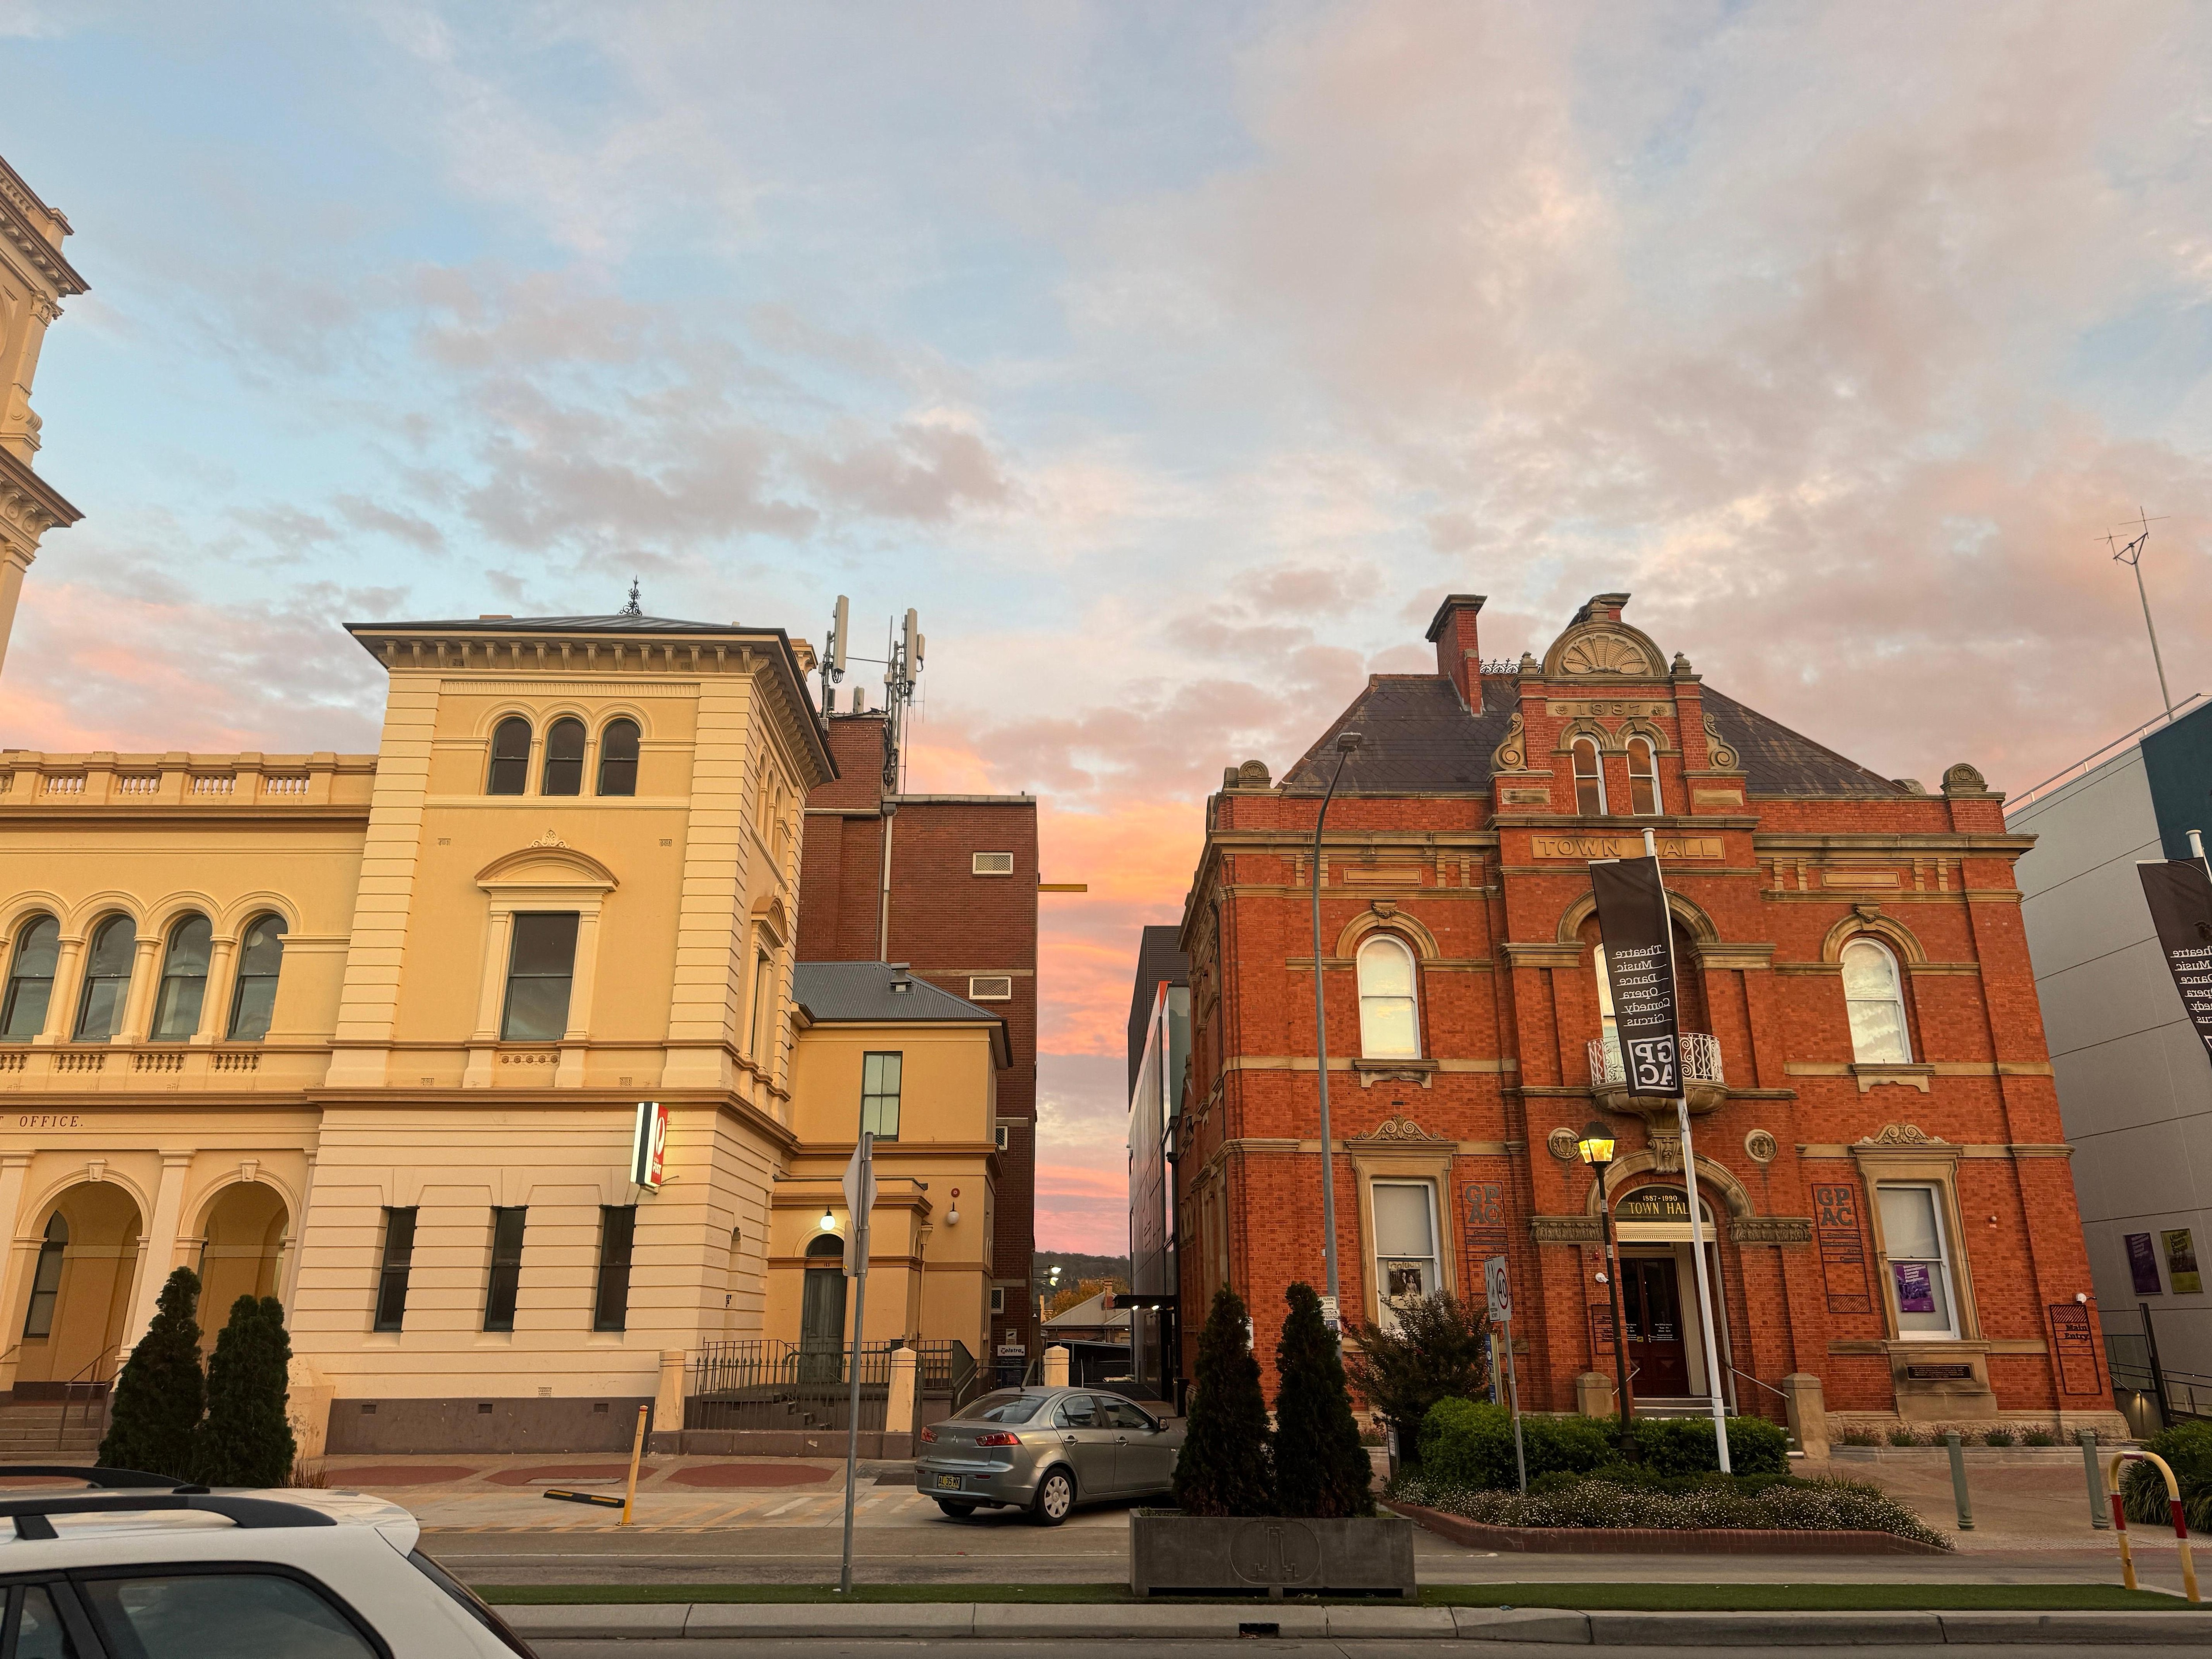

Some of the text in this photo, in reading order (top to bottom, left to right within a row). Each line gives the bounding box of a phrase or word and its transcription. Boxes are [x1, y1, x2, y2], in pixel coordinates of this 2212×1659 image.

[1577, 703, 1640, 715] 1887
[1539, 839, 1719, 857] TOWN ALL
[20, 1116, 83, 1127] OFFICE.
[653, 1161, 661, 1175] POST
[1466, 1185, 1499, 1204] GP
[1817, 1188, 1850, 1206] GP
[1468, 1204, 1501, 1223] AC
[1628, 1202, 1690, 1214] TOWN HAL
[1821, 1207, 1853, 1225] AC
[1498, 1279, 1507, 1298] 40
